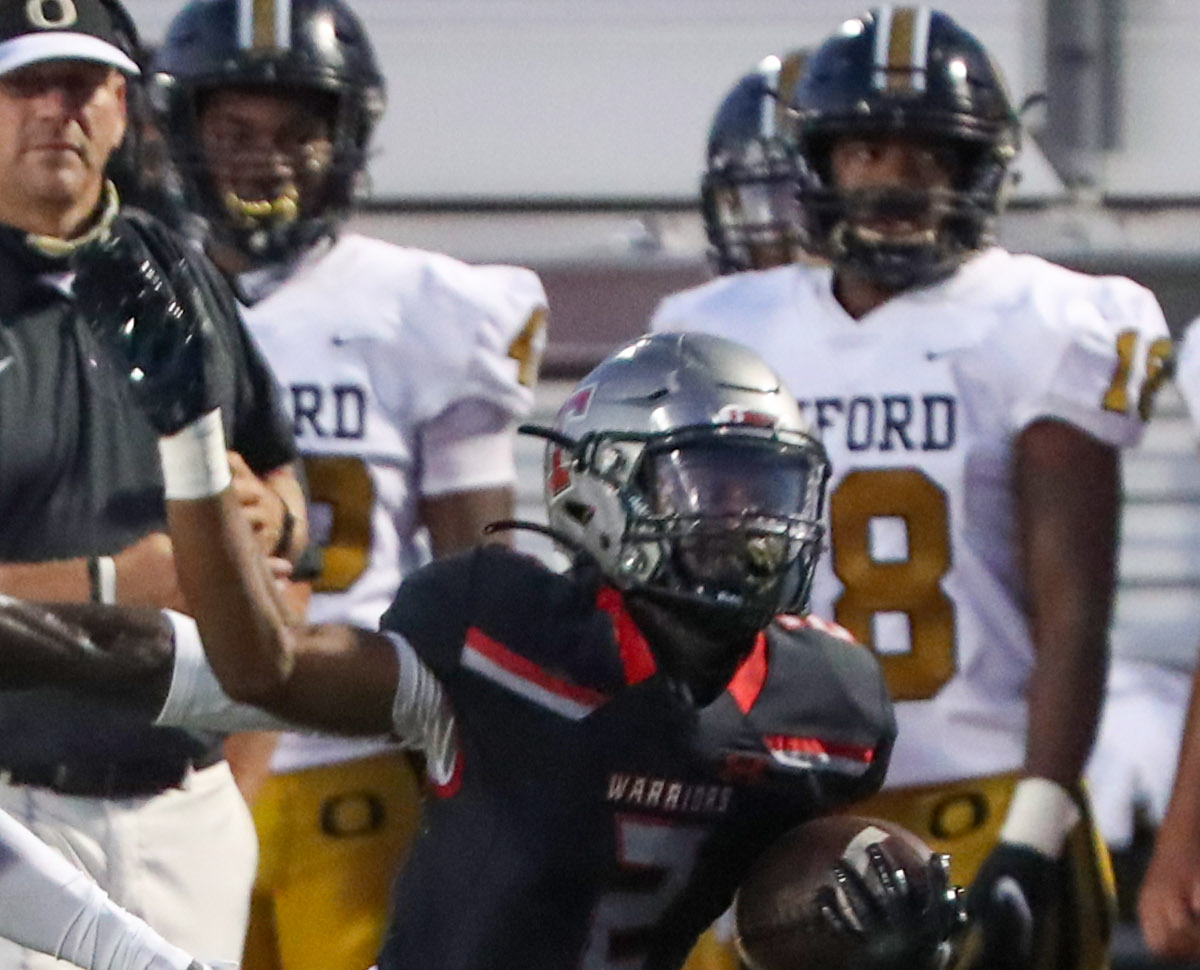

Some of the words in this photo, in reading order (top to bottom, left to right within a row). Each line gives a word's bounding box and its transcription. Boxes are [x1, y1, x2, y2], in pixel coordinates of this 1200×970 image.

[26, 0, 78, 29] O
[320, 789, 386, 840] O
[606, 773, 734, 812] WARRIORS
[929, 791, 989, 841] O
